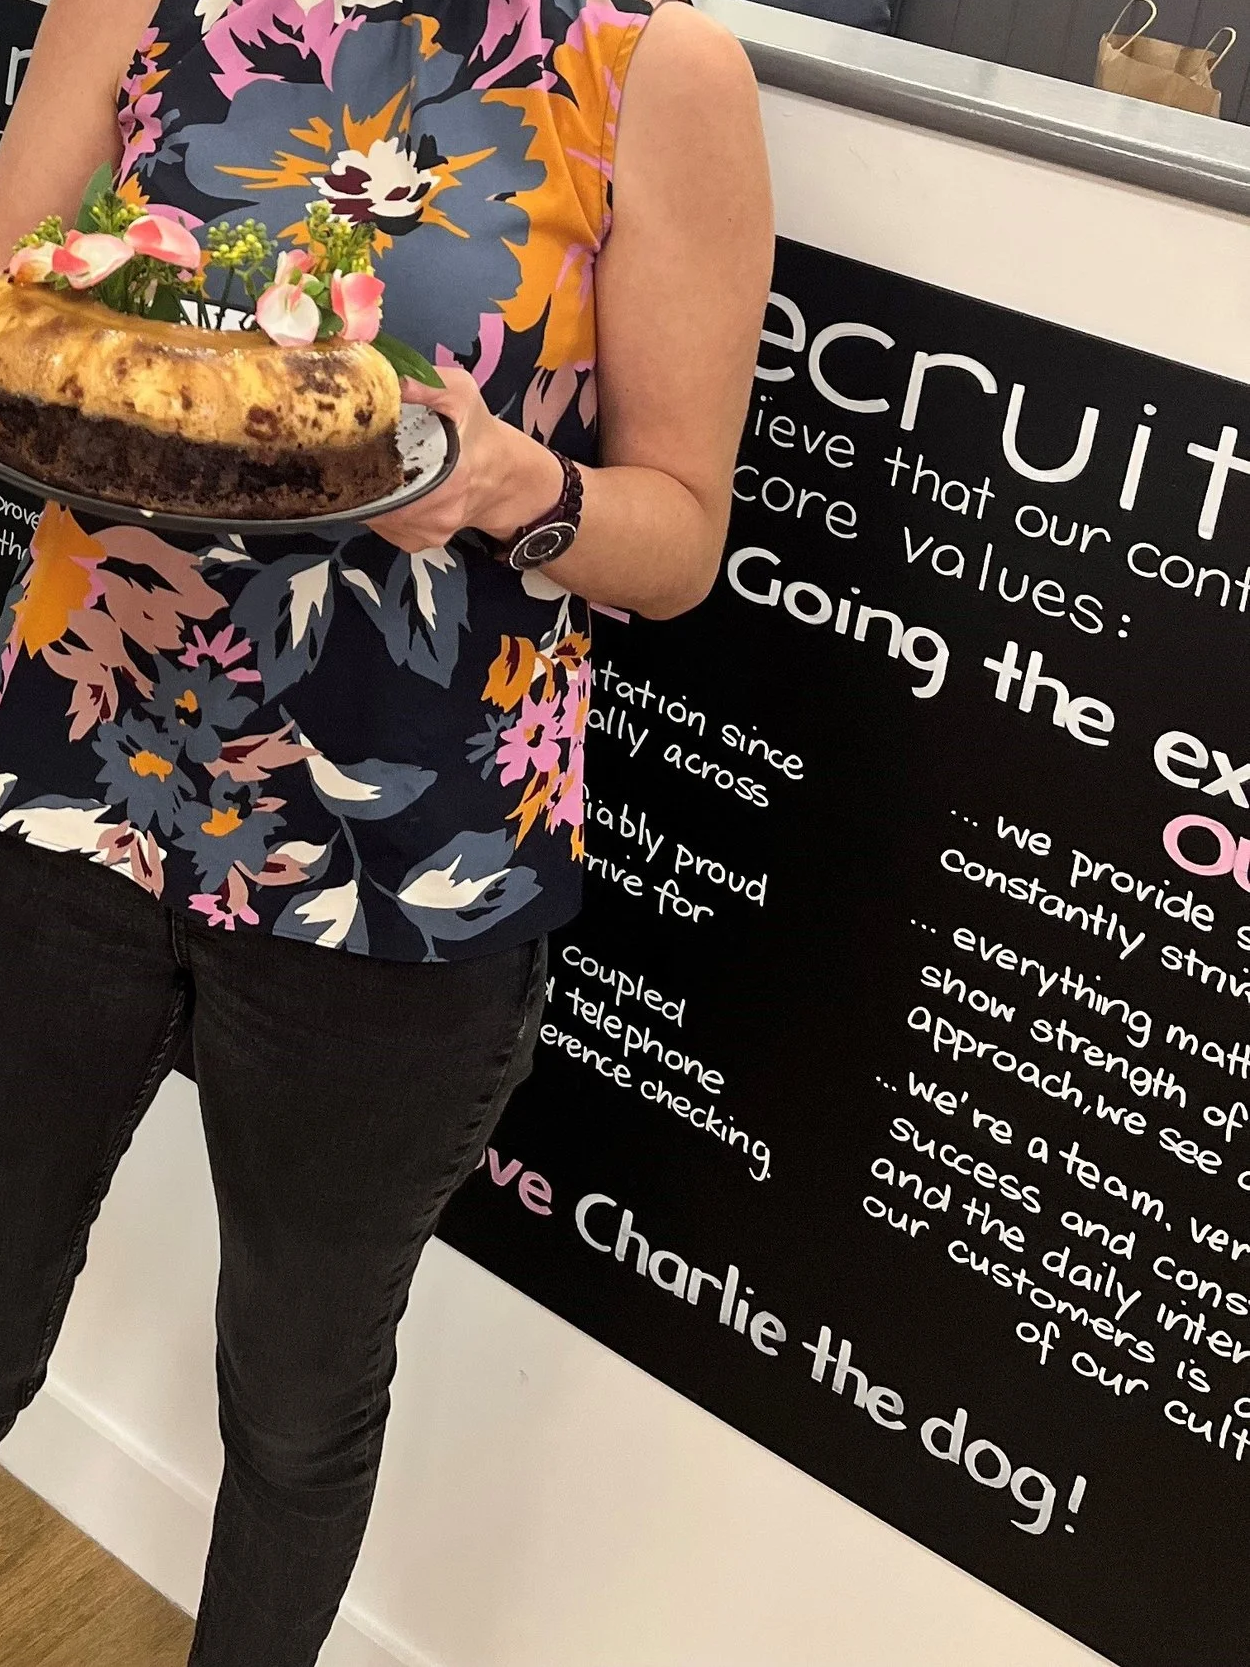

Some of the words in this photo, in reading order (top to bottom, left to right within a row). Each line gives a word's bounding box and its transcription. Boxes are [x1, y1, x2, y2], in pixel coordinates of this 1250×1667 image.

[732, 465, 858, 539] core
[904, 526, 1130, 638] values:
[884, 446, 995, 519] that
[1015, 506, 1111, 553] our
[727, 546, 949, 699] Going
[984, 641, 1115, 746] the
[587, 706, 649, 757] ally
[664, 744, 769, 807] across
[722, 725, 804, 780] since
[584, 851, 644, 896] rive
[654, 879, 714, 923] for
[675, 844, 768, 907] proud
[940, 848, 1146, 960] constantly
[1161, 945, 1250, 1003] striv
[997, 815, 1052, 856] we
[1071, 849, 1215, 932] provide
[562, 945, 686, 1028] coupled
[565, 987, 726, 1095] telephone
[953, 927, 1152, 1048] everything
[540, 1024, 632, 1087] erence
[640, 1080, 772, 1180] checking.
[921, 965, 1016, 1022] show
[1030, 1018, 1187, 1108] strength
[1203, 1101, 1249, 1142] of
[1028, 1137, 1049, 1164] a
[1159, 1127, 1222, 1174] see
[871, 1157, 952, 1213] and
[962, 1196, 1026, 1253] the
[1042, 1246, 1142, 1321] daily
[890, 1118, 1042, 1214] success
[1061, 1209, 1136, 1260] and
[1153, 1256, 1250, 1315] cons
[475, 1146, 553, 1215] ve
[575, 1192, 787, 1358] Charlie
[803, 1325, 907, 1432] the
[920, 1407, 1086, 1535] dog!
[863, 1194, 930, 1239] our
[948, 1239, 1156, 1364] customers
[1177, 1359, 1211, 1393] is
[1016, 1320, 1061, 1367] of
[1072, 1350, 1150, 1397] our
